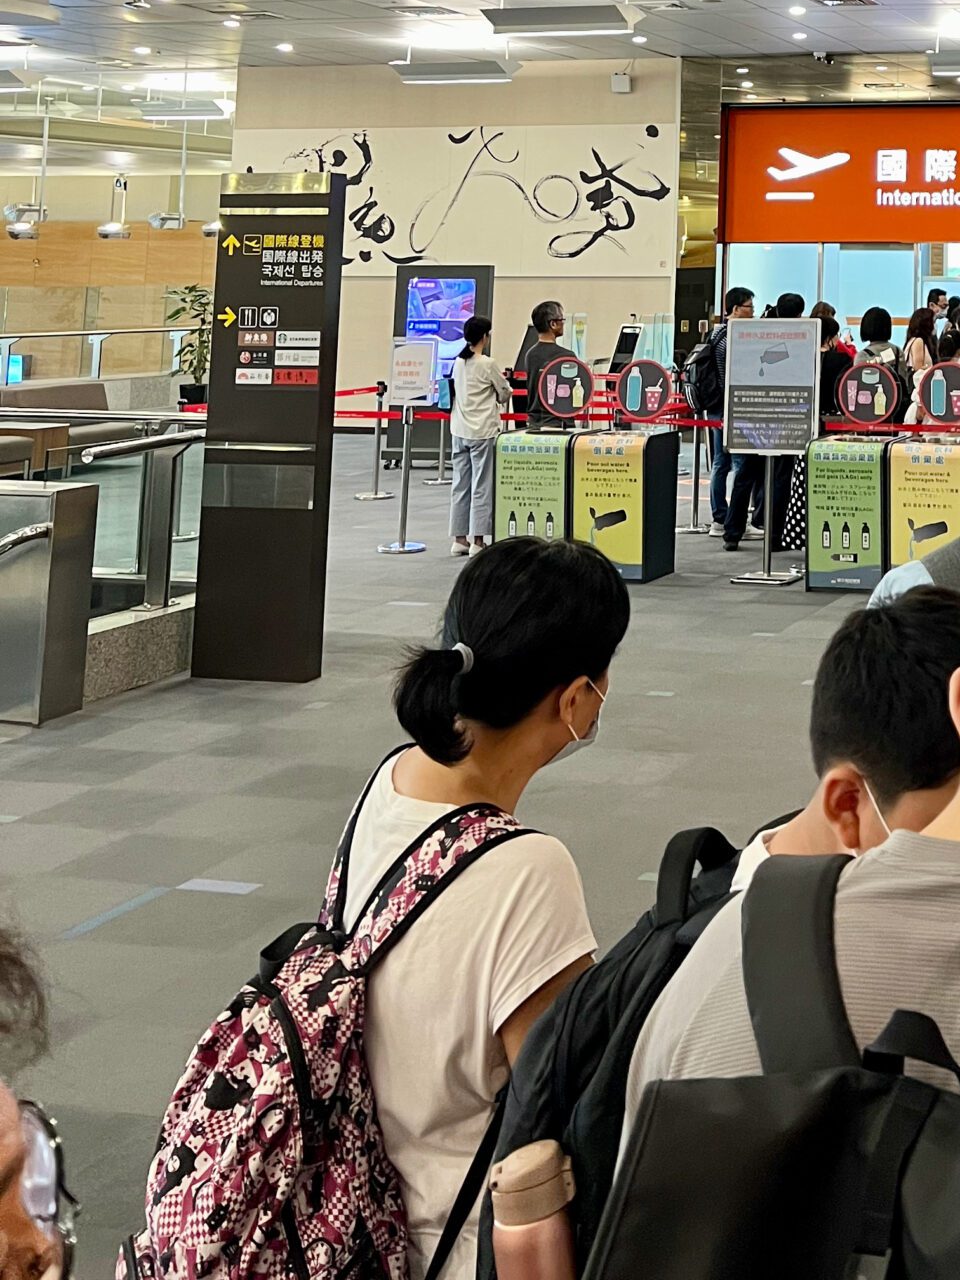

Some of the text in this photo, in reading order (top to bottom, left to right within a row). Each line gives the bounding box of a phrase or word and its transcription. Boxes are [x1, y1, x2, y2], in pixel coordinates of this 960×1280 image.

[262, 235, 325, 248] 國際線登機
[261, 250, 324, 263] 国際線出発
[261, 265, 324, 278] 국제선 탑승
[294, 279, 324, 287] Departures
